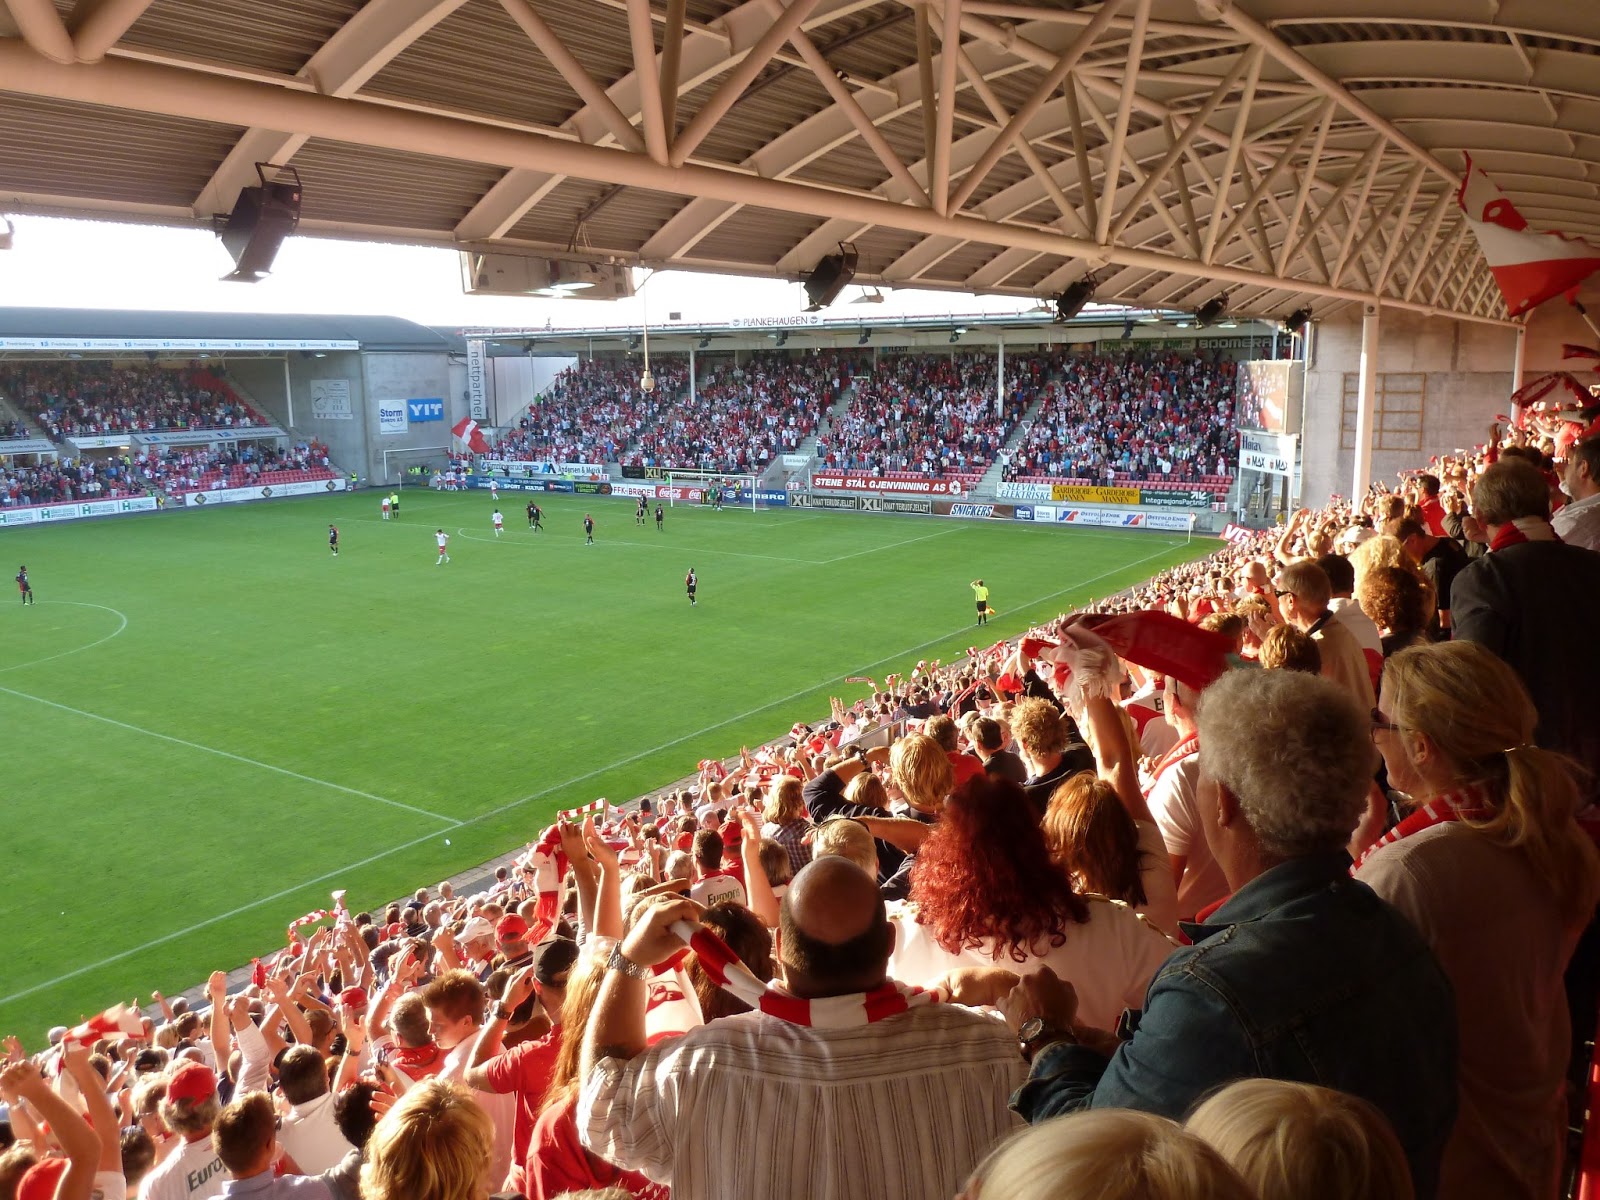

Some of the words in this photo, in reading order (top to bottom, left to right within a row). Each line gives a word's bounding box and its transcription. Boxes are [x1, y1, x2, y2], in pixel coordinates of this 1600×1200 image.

[743, 316, 808, 326] PLANKEHAUGEN
[469, 351, 483, 418] nettpartner
[380, 408, 403, 418] Storm
[409, 403, 442, 416] YIT
[1252, 455, 1265, 468] MAX
[646, 468, 659, 478] XL
[815, 478, 843, 487] STENE
[846, 478, 867, 488] STÅL
[868, 480, 930, 492] GJENVINNING
[932, 483, 946, 492] AS
[1006, 483, 1037, 491] SLEVIK
[792, 494, 812, 506] XL
[1001, 490, 1050, 500] ELEKTRISKE
[1146, 496, 1206, 506] IntegrasjonsPartner
[862, 498, 882, 512] XL
[951, 504, 993, 516] SNICKERS
[1224, 524, 1252, 543] VG
[188, 1157, 228, 1192] Euro
